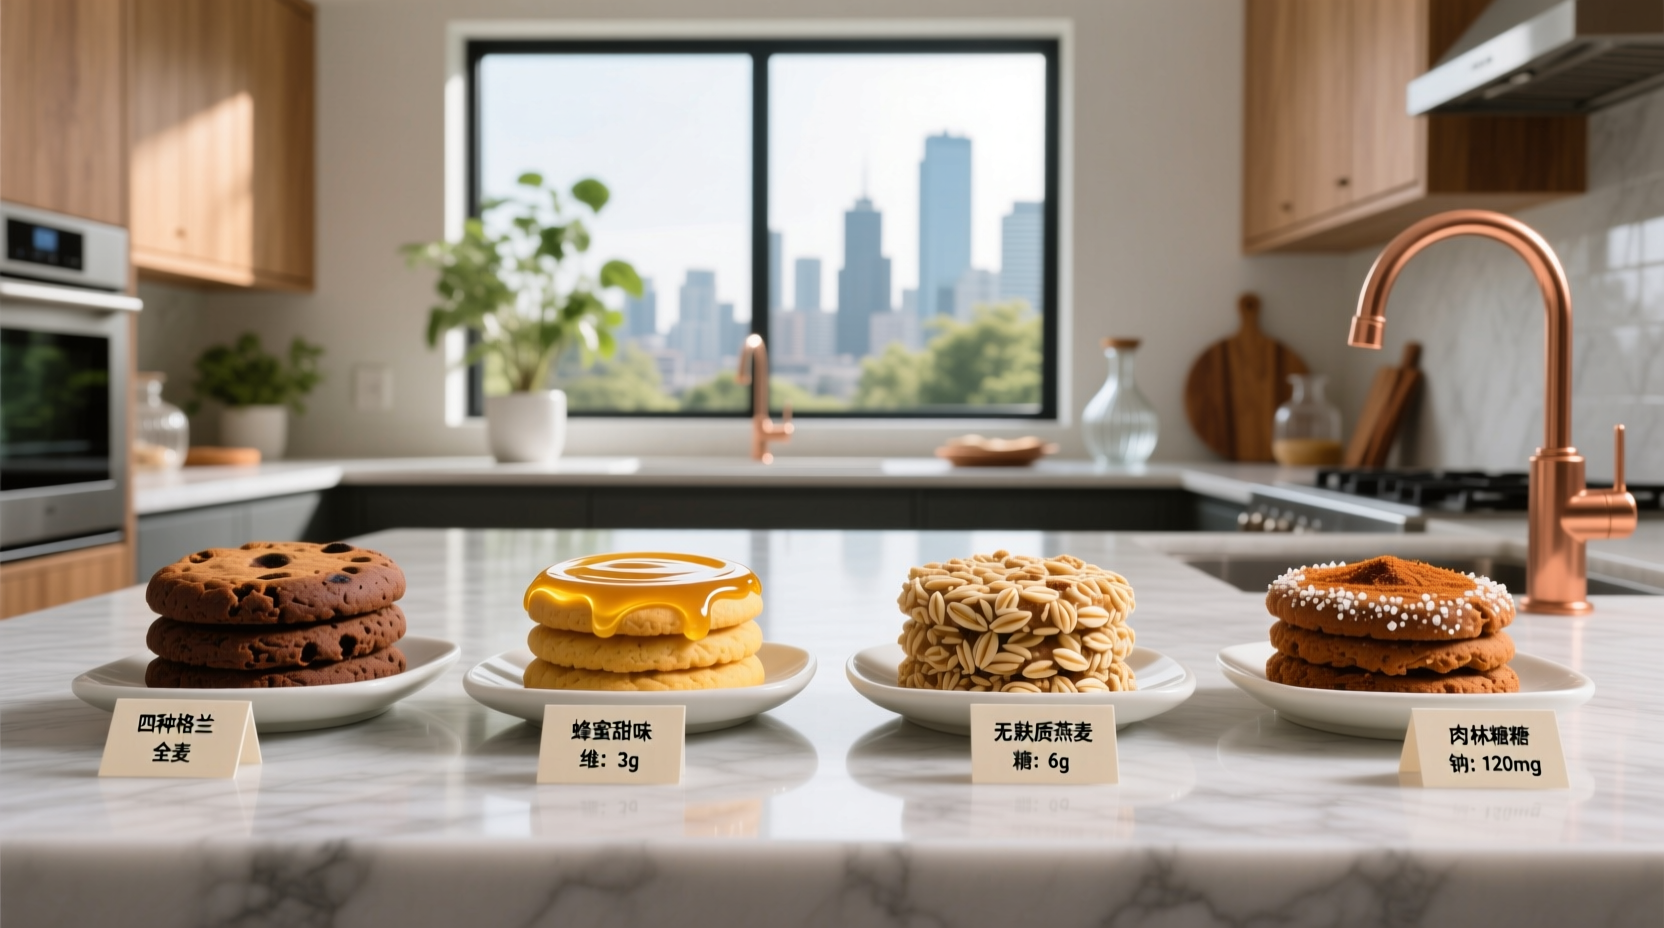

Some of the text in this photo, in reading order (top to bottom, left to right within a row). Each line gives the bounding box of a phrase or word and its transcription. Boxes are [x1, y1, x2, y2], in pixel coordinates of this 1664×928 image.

[137, 713, 215, 735] 四种格兰
[570, 719, 653, 743] 蜂蜜甜味
[151, 742, 192, 764] 全麦
[1481, 756, 1542, 777] 120mg
